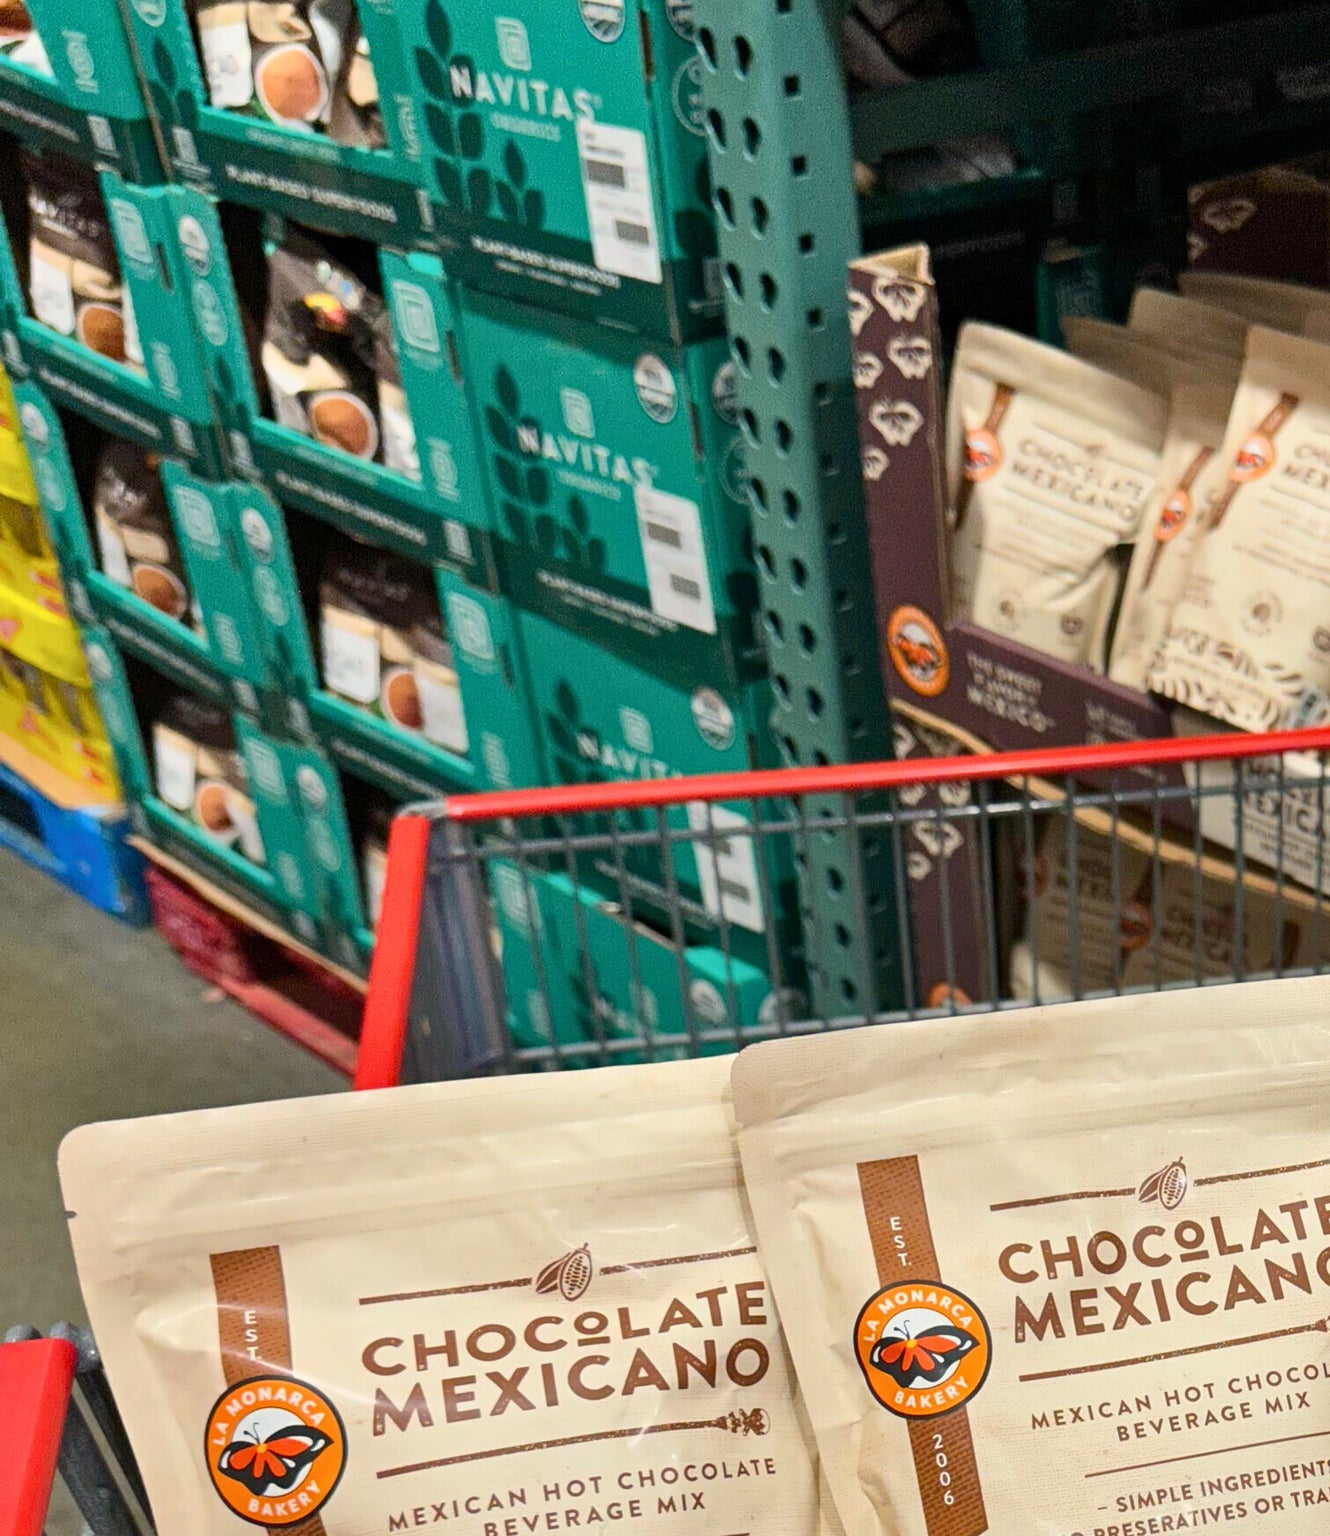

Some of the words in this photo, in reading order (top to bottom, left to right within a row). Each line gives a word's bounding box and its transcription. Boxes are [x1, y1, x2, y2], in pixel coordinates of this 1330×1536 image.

[889, 1215, 912, 1268] EST.
[244, 1309, 261, 1361] EST.
[863, 1319, 880, 1342] LA
[878, 1289, 974, 1328] MONARCA
[372, 1337, 770, 1436] MEXICANO
[894, 1375, 969, 1409] BAKERY
[1031, 1395, 1152, 1430] MEXICAN
[1165, 1383, 1216, 1407] HOT
[213, 1422, 229, 1446] LA
[226, 1386, 326, 1426] MONARCA
[1117, 1403, 1253, 1442] BEVERAGE
[1265, 1391, 1311, 1414] MIX
[388, 1487, 526, 1532] MEXICAN
[543, 1476, 603, 1500] HOT
[617, 1458, 777, 1490] CHOCOLATE
[932, 1434, 955, 1506] 2006
[248, 1480, 322, 1516] BAKERY
[657, 1492, 706, 1513] MIX
[1116, 1484, 1194, 1513] SIMPLE
[1254, 1495, 1285, 1514] OR
